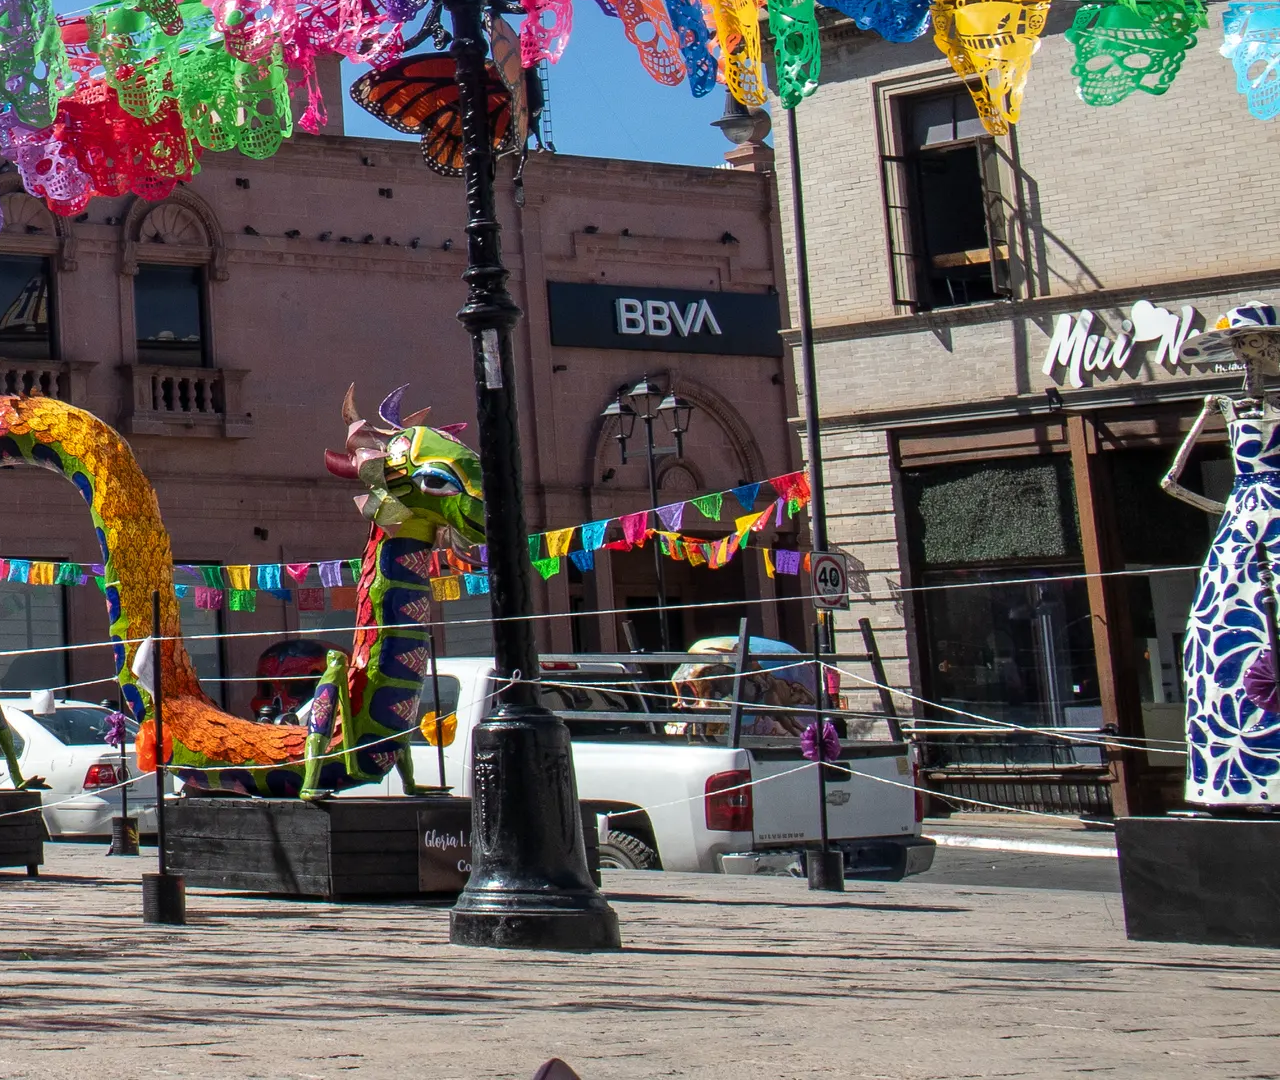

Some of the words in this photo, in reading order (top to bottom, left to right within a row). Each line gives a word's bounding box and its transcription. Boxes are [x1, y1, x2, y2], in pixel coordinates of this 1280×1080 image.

[615, 298, 722, 337] BBVA
[1042, 309, 1133, 388] Mui
[1154, 305, 1199, 365] N
[818, 566, 840, 588] 40
[425, 829, 458, 851] Gloria
[457, 860, 472, 872] Co
